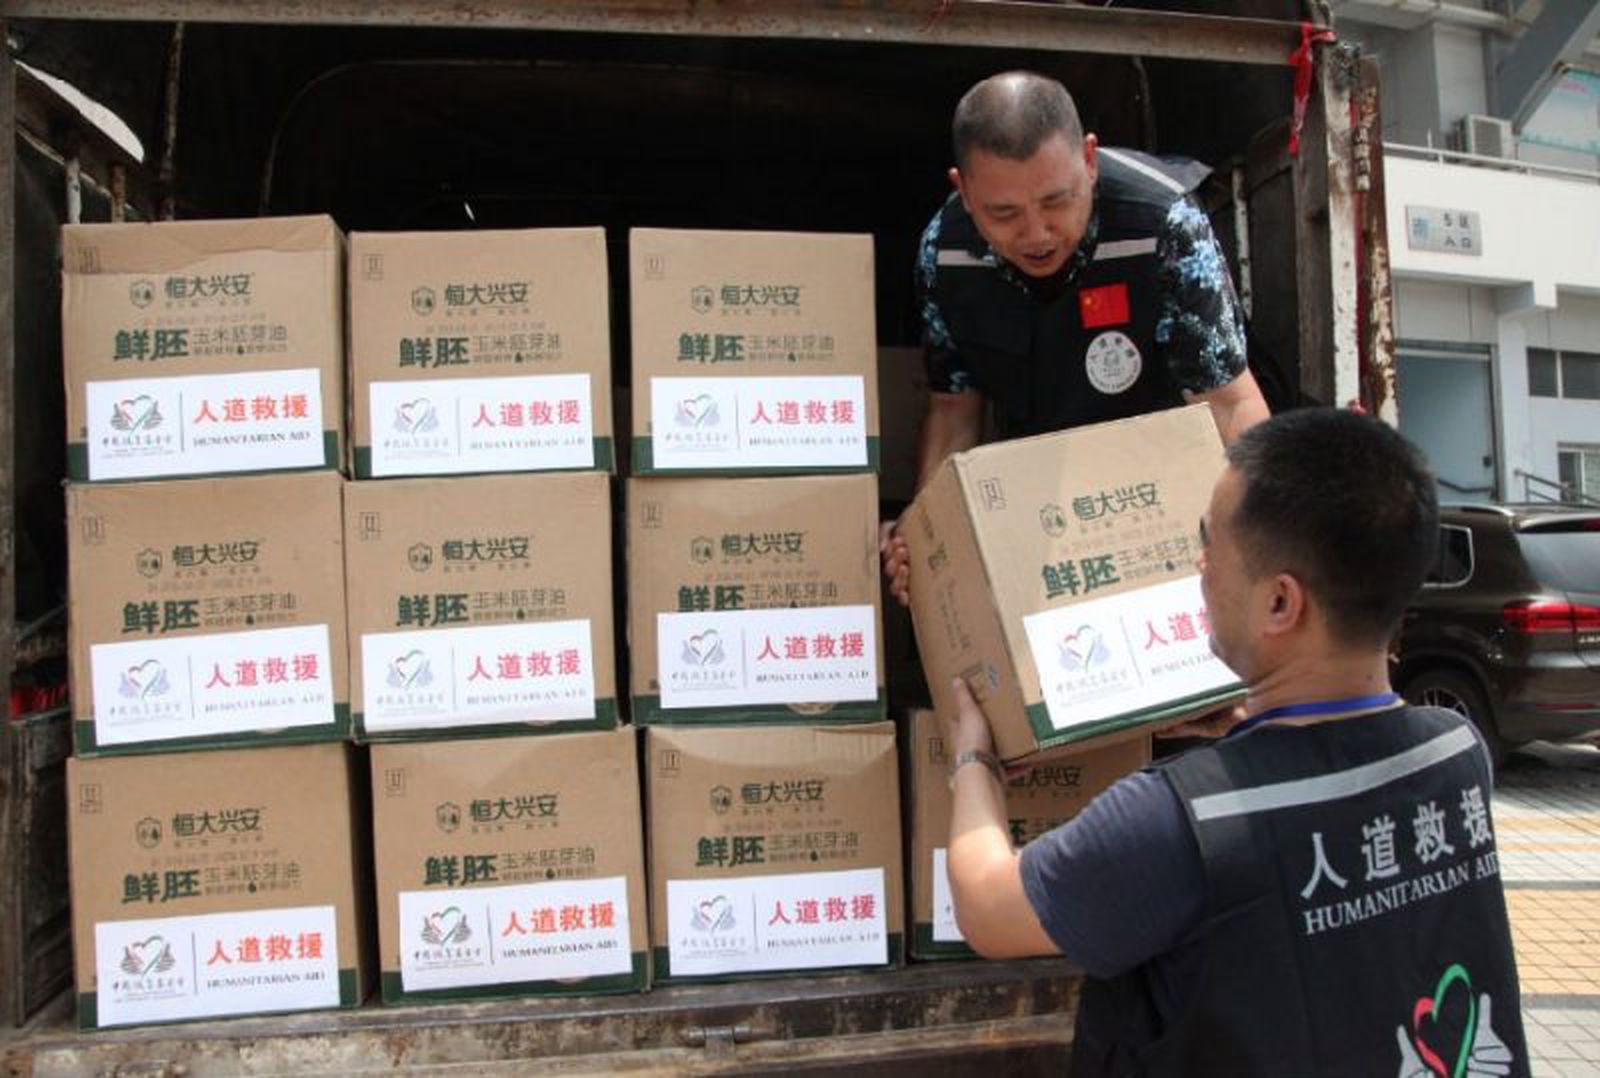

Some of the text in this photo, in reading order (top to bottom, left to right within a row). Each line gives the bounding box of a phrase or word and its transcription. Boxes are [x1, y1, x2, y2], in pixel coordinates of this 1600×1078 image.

[165, 274, 250, 299] 恒大兴安
[445, 282, 529, 306] 恒大兴安
[720, 285, 801, 306] 恒大兴安
[113, 328, 189, 360] 鲜胚
[399, 337, 469, 369] 鲜胚
[677, 333, 745, 363] 鲜胚
[193, 394, 308, 423] 人道救援
[472, 400, 580, 427] 人道救援
[750, 400, 855, 424] 人道救援
[1072, 483, 1159, 522] 恒大兴安
[172, 541, 257, 566] 恒大兴安
[442, 537, 529, 561] 恒大兴安
[721, 532, 803, 556] 恒大兴安
[1041, 554, 1121, 600] 鲜胚
[122, 599, 199, 633] 鲜胚
[396, 593, 469, 627] 鲜胚
[757, 632, 864, 661] 人道救援
[205, 654, 319, 689] 人道救援
[467, 649, 580, 681] 人道救援
[470, 794, 558, 822] 恒大兴安
[741, 780, 825, 804] 恒大兴安
[172, 809, 260, 837] 恒大兴安
[696, 836, 765, 868] 鲜胚
[1300, 784, 1492, 899] 人道救援
[423, 854, 498, 886] 鲜胚
[121, 869, 200, 904] 鲜胚
[1302, 862, 1470, 936] HUMANITARIAN
[502, 901, 615, 936] 人道救援
[768, 894, 876, 926] 人道救援
[207, 933, 322, 966] 人道救援
